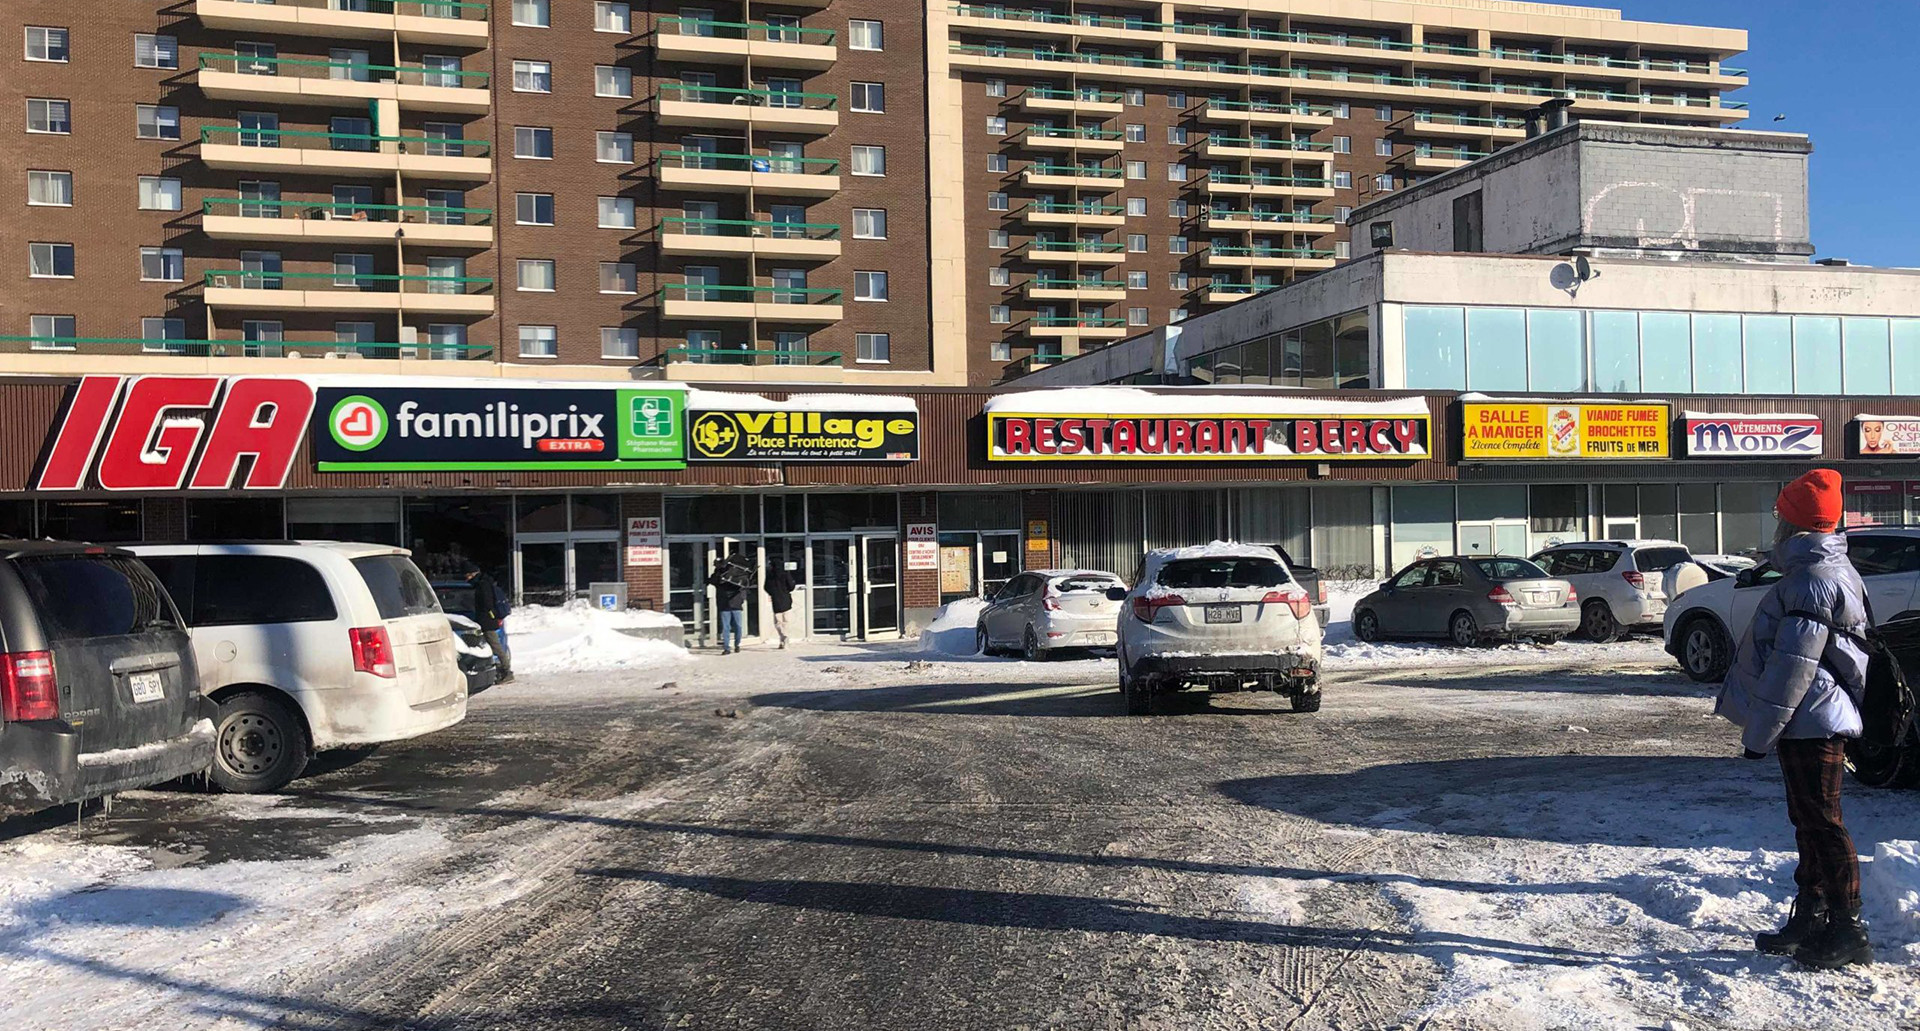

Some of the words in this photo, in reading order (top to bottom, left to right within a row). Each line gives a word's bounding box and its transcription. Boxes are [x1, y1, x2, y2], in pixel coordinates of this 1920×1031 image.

[1480, 410, 1529, 423] SALLE
[1587, 410, 1623, 421] VIANDE
[396, 401, 605, 449] familiprix
[734, 412, 915, 449] Village
[1588, 425, 1656, 437] BROCHETTES
[1733, 421, 1782, 433] VÊTEMENTS
[36, 374, 317, 491] IGA
[1006, 418, 1272, 454] RESTAURANT
[1295, 419, 1416, 454] BERCY
[1482, 426, 1543, 438] MANGER
[549, 441, 592, 450] EXTRA
[747, 434, 785, 448] Place
[788, 434, 857, 448] Frontenac
[1470, 439, 1501, 450] Licence
[1587, 441, 1624, 452] FRUITS
[1638, 441, 1659, 452] MER
[632, 520, 658, 529] AVIS
[911, 526, 934, 535] AVIS
[64, 708, 100, 718] DODGE
